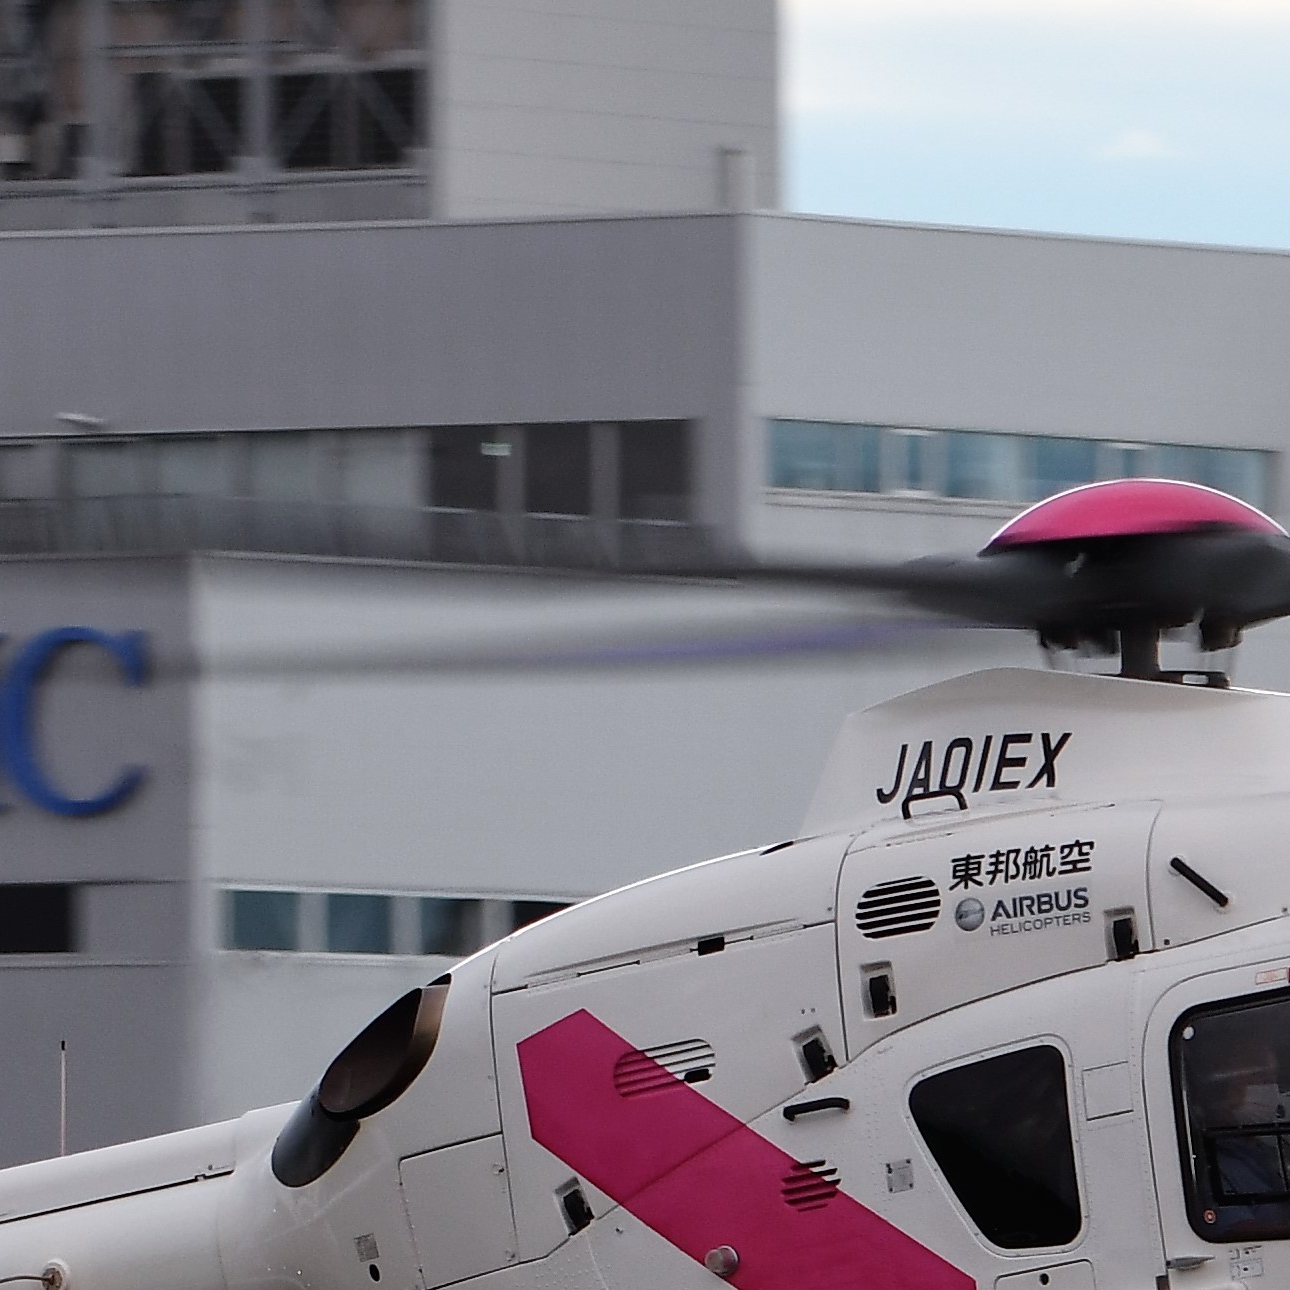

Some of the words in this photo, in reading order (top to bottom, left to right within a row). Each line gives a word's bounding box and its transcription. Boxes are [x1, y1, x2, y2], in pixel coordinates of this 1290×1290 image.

[949, 839, 1095, 891] 東邦航空
[991, 887, 1089, 921] AIRBUS
[990, 911, 1091, 936] HELICOPTERS
